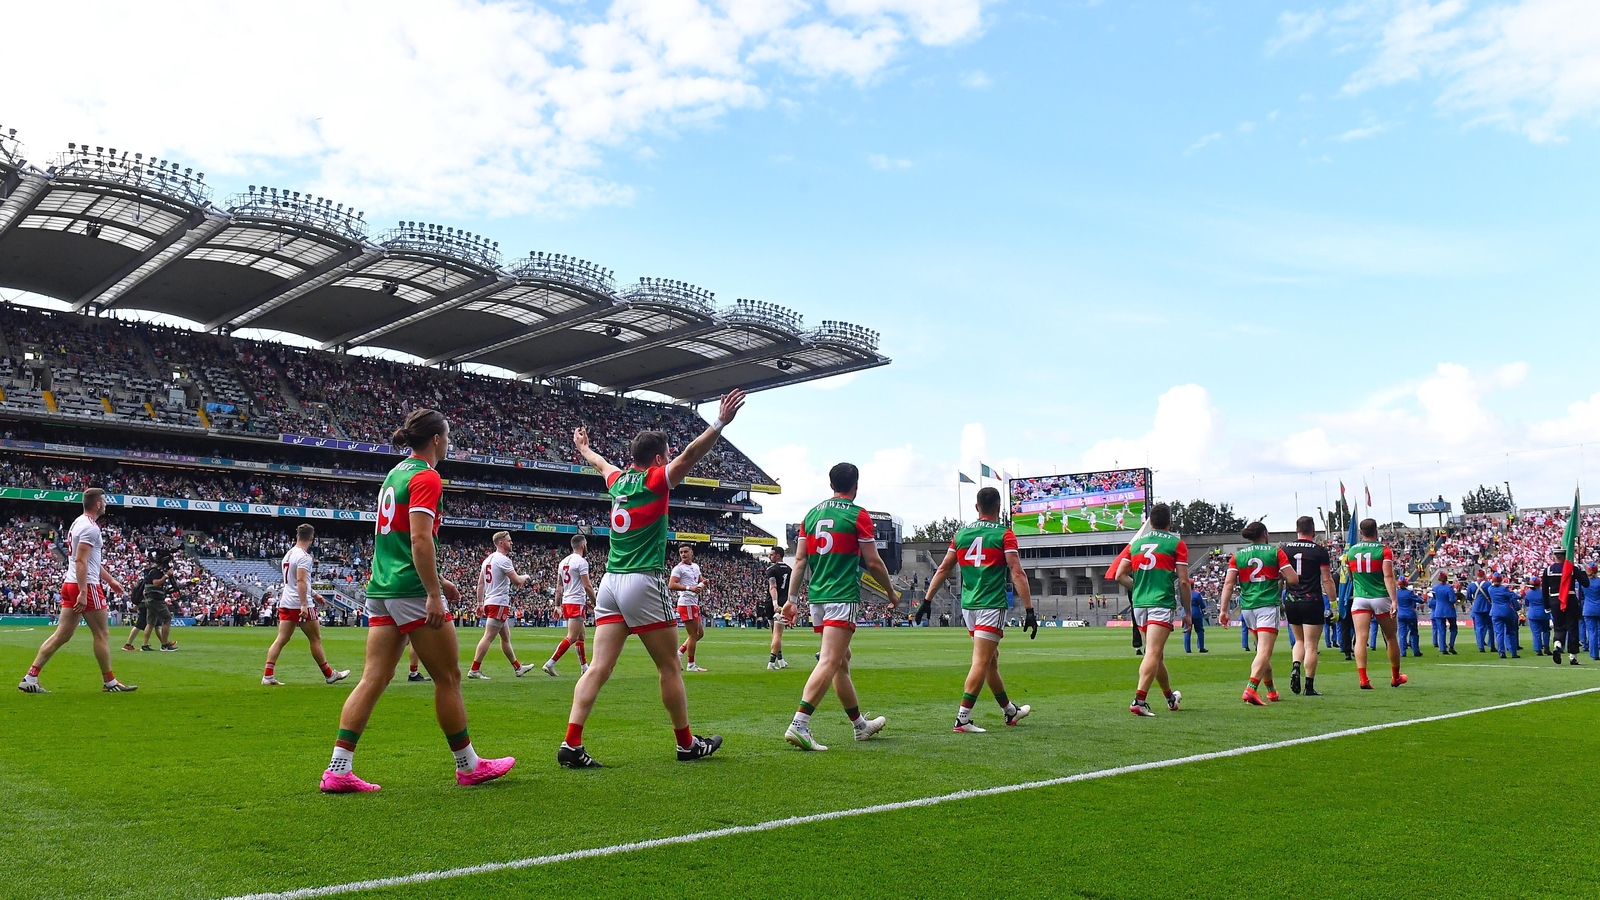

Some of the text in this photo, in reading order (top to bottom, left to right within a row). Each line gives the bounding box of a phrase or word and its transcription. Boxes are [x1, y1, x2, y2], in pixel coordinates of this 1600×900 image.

[580, 466, 600, 474] Centr
[105, 495, 117, 503] AA
[1118, 492, 1135, 500] AIB
[131, 497, 149, 505] GAA
[163, 499, 182, 508] GAA
[195, 502, 212, 510] GAA
[225, 504, 242, 512] GAA
[375, 486, 396, 535] 19
[1417, 503, 1435, 511] GAA
[283, 507, 300, 515] GAA
[312, 509, 327, 517] GAA
[339, 511, 355, 519] GAA
[611, 495, 631, 533] 6
[534, 523, 557, 531] Centra
[815, 519, 834, 555] 5
[964, 536, 986, 567] 4
[1240, 545, 1272, 553] PORTWEST
[1138, 543, 1159, 570] 3
[1293, 552, 1303, 575] 1
[1354, 552, 1372, 573] 11
[283, 562, 290, 584] 7
[485, 564, 493, 583] 5
[1247, 557, 1266, 582] 2
[562, 566, 571, 584] 3
[780, 573, 789, 589] 1
